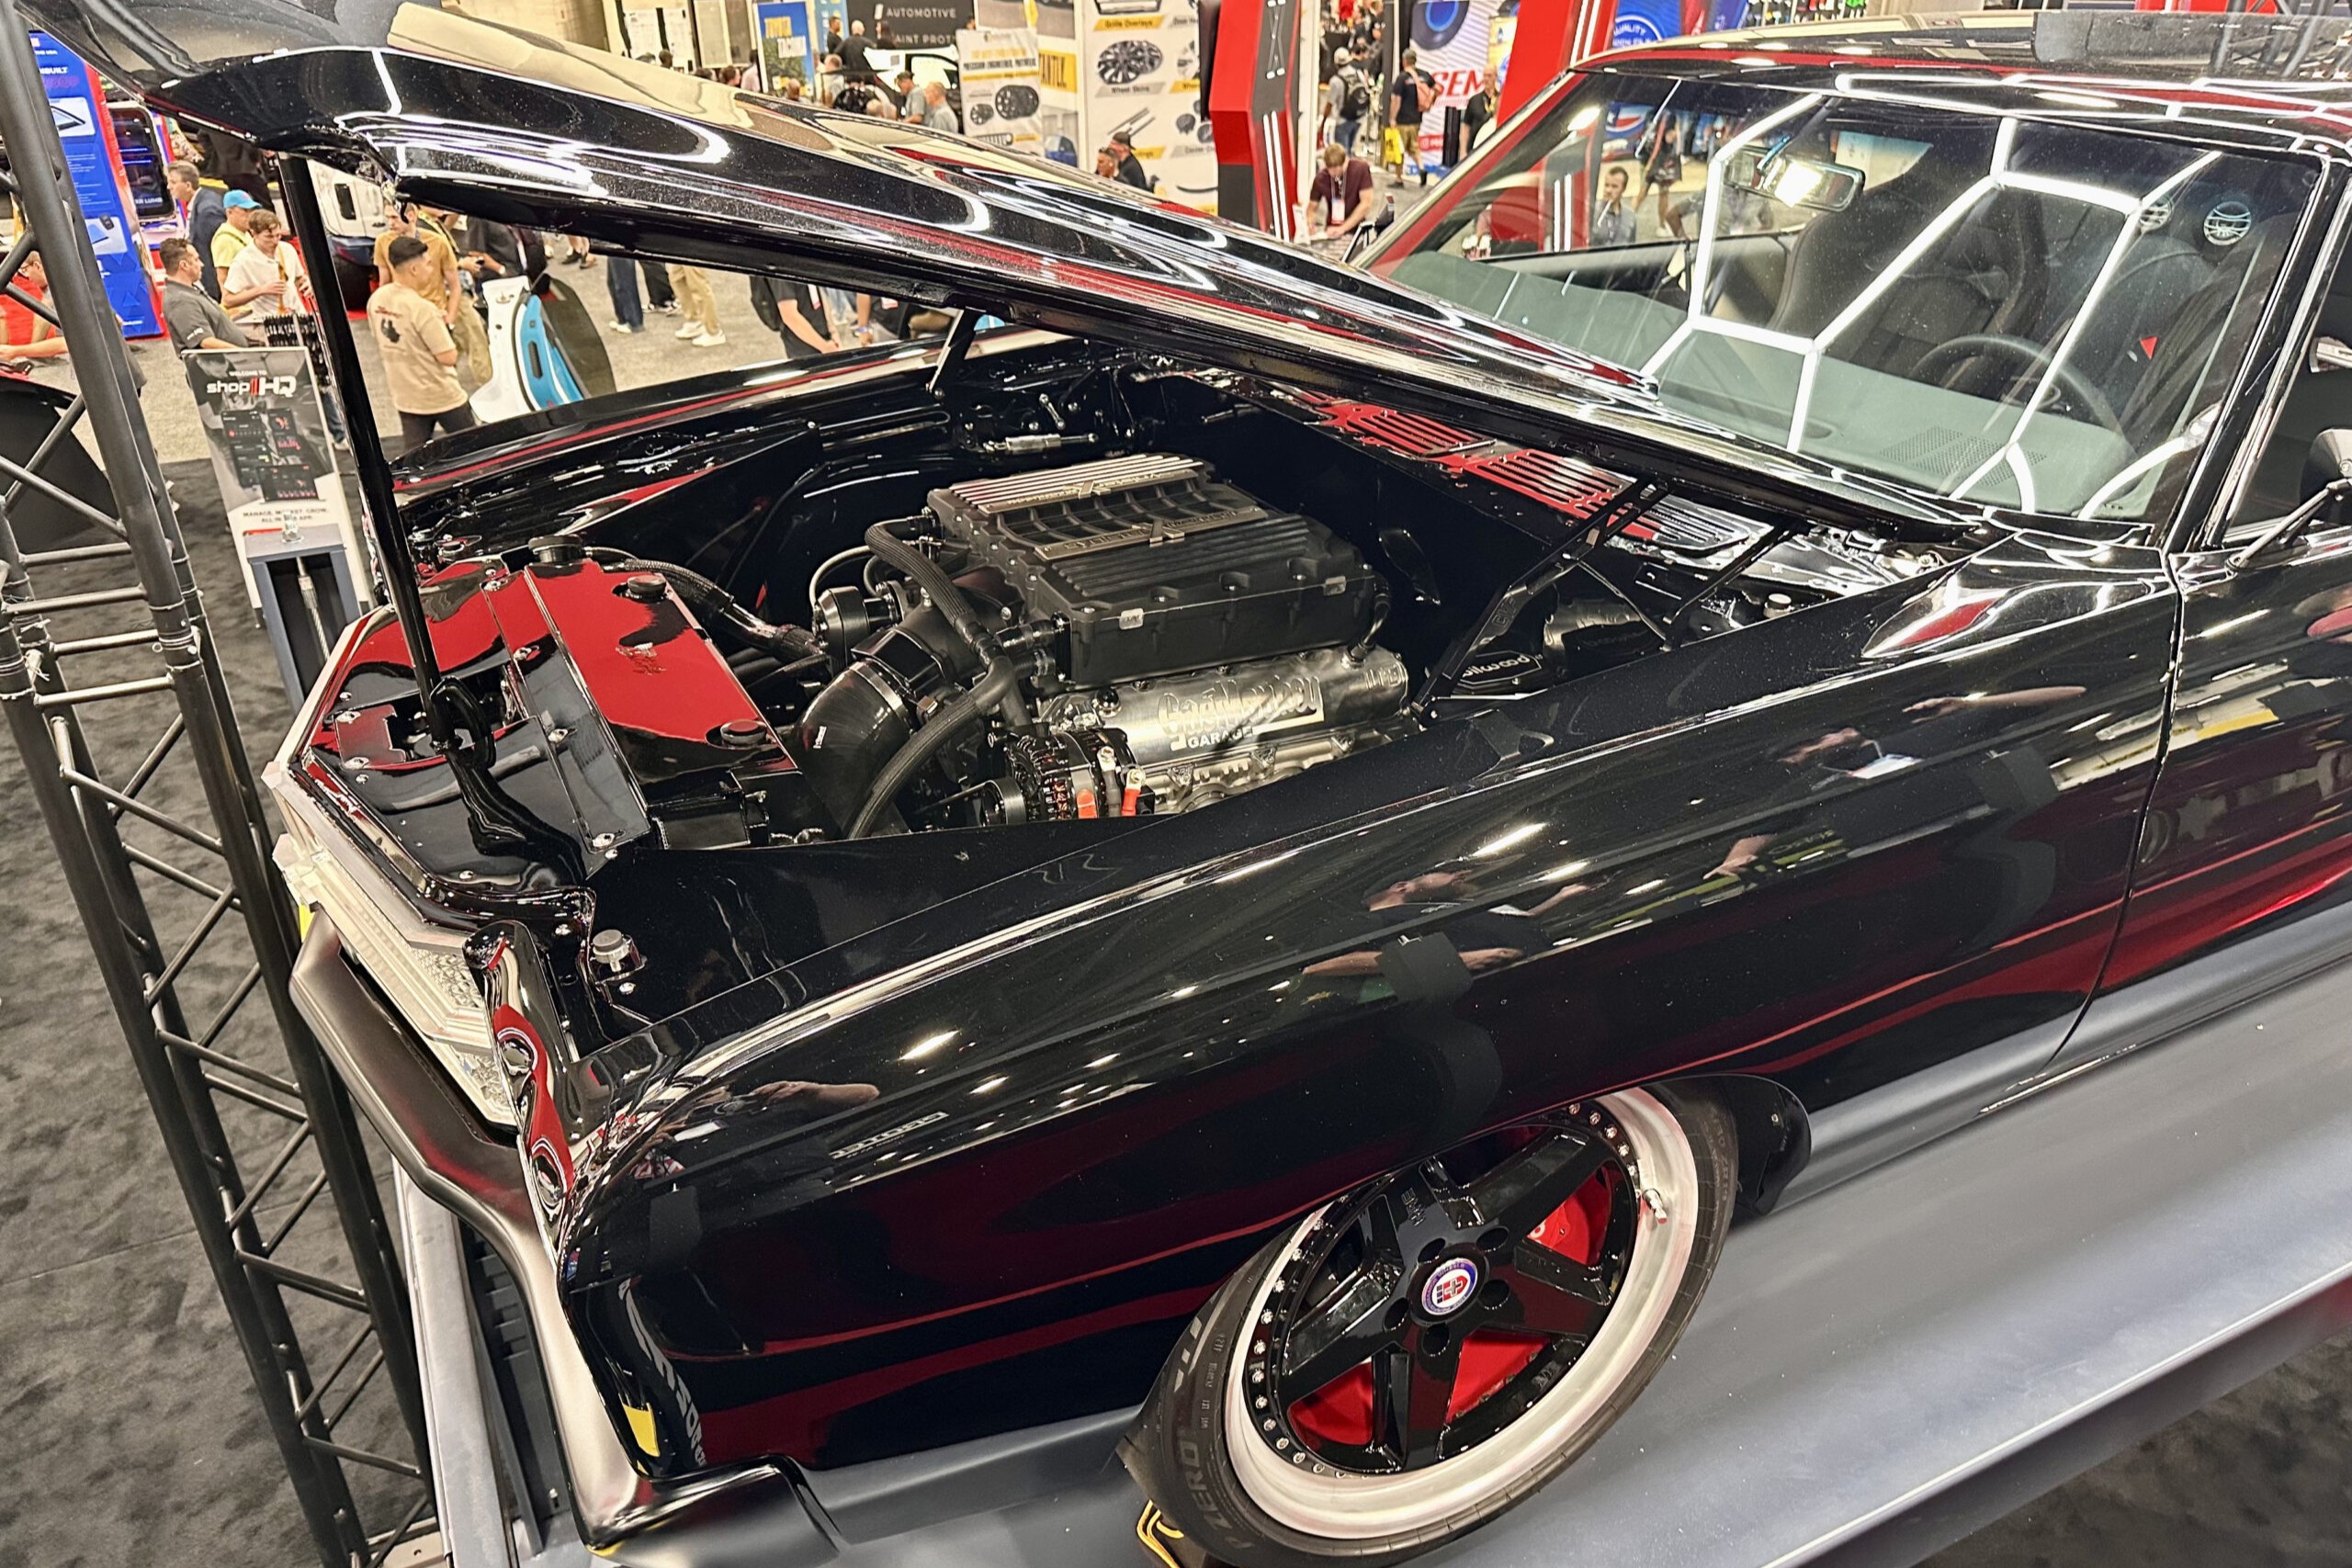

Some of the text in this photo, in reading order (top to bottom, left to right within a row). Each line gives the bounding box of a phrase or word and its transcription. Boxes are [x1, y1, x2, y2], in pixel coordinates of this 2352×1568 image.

[886, 7, 956, 18] AUTOMOTIVE
[1430, 70, 1486, 97] SEM
[1187, 726, 1253, 750] GARAGE
[1180, 1439, 1233, 1530] ZERO
